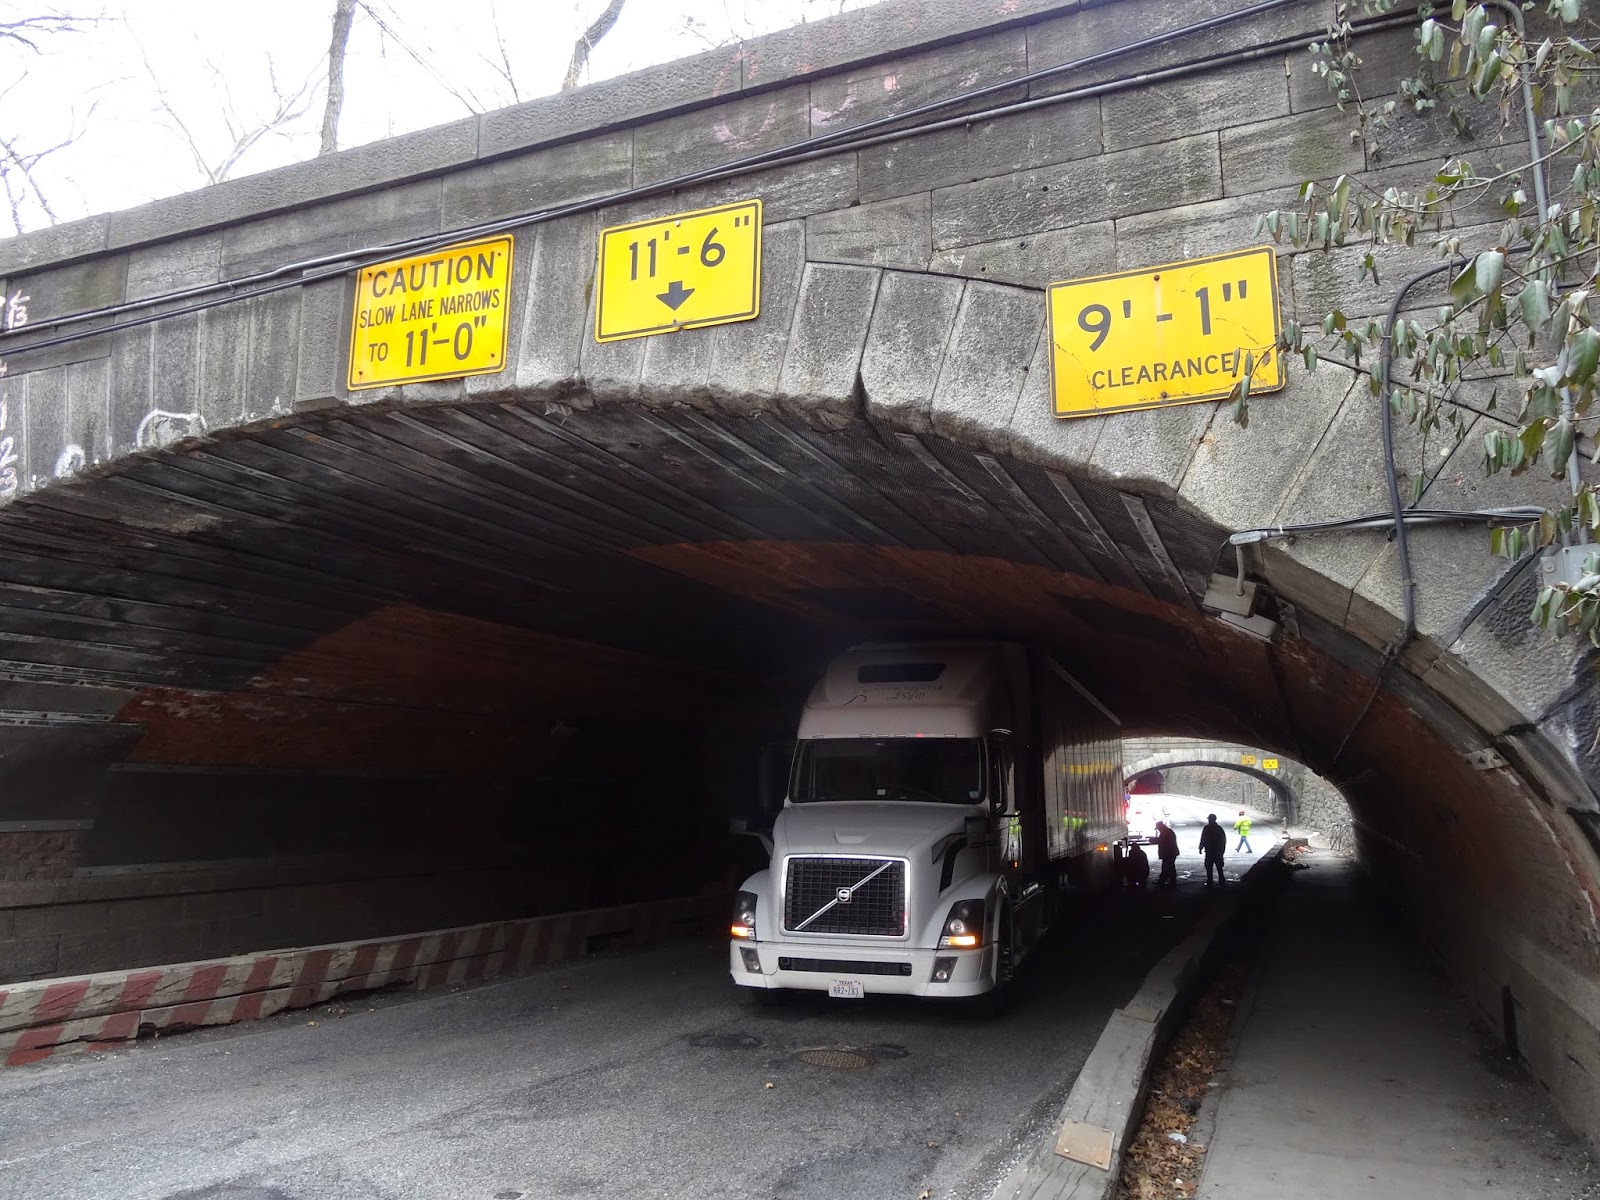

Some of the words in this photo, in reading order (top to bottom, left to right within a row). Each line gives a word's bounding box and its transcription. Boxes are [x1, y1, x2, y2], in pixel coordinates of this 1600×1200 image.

[372, 251, 494, 298] CAUTION
[359, 305, 396, 329] SLOW
[401, 299, 434, 322] LANE
[439, 289, 500, 316] NARROWS
[369, 342, 389, 362] TO
[406, 315, 487, 367] 11'-0"
[1092, 352, 1234, 390] CLEARANCE
